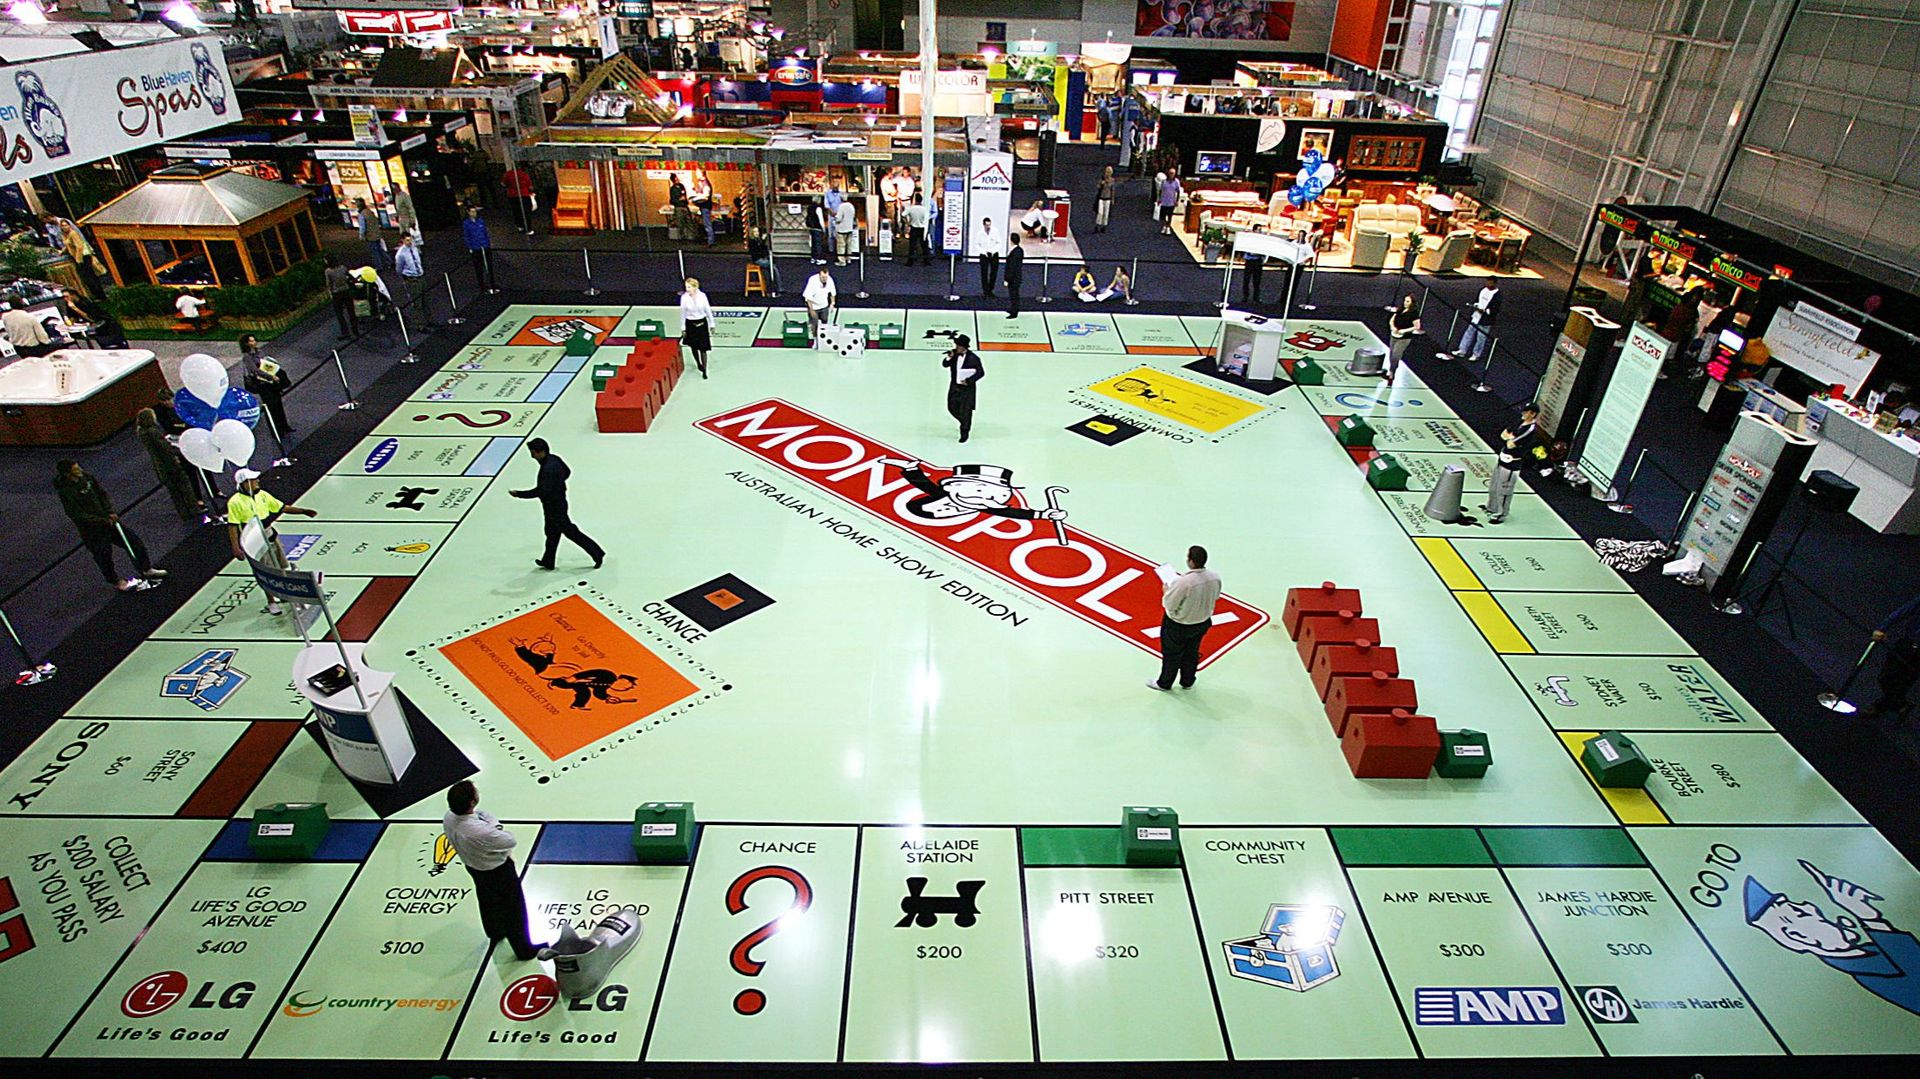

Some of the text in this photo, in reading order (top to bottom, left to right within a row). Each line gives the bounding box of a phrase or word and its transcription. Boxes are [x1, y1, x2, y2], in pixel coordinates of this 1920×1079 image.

[116, 77, 202, 138] Spas
[981, 176, 1006, 185] 100%
[1606, 210, 1624, 225] micro
[1658, 233, 1680, 250] micro
[1720, 261, 1744, 279] micro
[1309, 324, 1364, 341] PARKING
[1068, 398, 1109, 416] CHEST
[1111, 413, 1194, 445] COMMUNITY
[363, 440, 399, 470] SAMSUNG
[316, 540, 338, 556] $200
[725, 470, 1029, 627] AUSTRALIAN HOME SHOW EDITION
[1478, 551, 1505, 576] COLLINS
[1492, 553, 1515, 574] STREET
[192, 580, 259, 635] FREEDOM
[641, 601, 707, 645] CHANCE
[1524, 605, 1560, 640] ELIZABETH
[1540, 611, 1568, 636] STREET
[1583, 675, 1618, 708] SYDNEY
[1601, 678, 1628, 705] WATER
[1638, 681, 1663, 701] $150
[1666, 664, 1742, 723] WATER
[8, 721, 110, 811] SONY
[104, 755, 132, 776] $60
[143, 749, 181, 783] STREET
[161, 750, 196, 781] SONY
[1650, 757, 1692, 797] BOURKE
[1668, 761, 1704, 794] STREET
[1711, 763, 1742, 789] $280
[739, 840, 817, 854] CHANCE
[900, 839, 979, 851] ADELAIDE
[1205, 839, 1306, 853] COMMUNITY
[104, 835, 151, 892] COLLECT
[906, 851, 974, 863] STATION
[1235, 853, 1286, 865] CHEST
[1705, 843, 1742, 872] TO
[61, 834, 125, 924] $200 SALARY
[246, 886, 272, 898] LG
[385, 887, 472, 900] COUNTRY
[586, 889, 609, 901] LG
[1060, 891, 1155, 904] PITT STREET
[1382, 891, 1493, 904] AMP AVENUE
[1536, 890, 1657, 903] JAMES HARDIE
[1690, 869, 1729, 908] GO
[28, 852, 88, 944] AS YOU PASS
[190, 899, 308, 913] LIFE'S GOOD
[382, 902, 458, 915] ENERGY
[1563, 904, 1649, 917] JUNCTION
[201, 915, 278, 928] AVENUE
[196, 939, 248, 954] $400
[379, 941, 425, 955] $100
[916, 944, 962, 959] $200
[1095, 944, 1139, 959] $320
[1439, 943, 1486, 958] $300
[1606, 942, 1653, 957] $300
[187, 981, 257, 1010] LG
[1632, 996, 1745, 1010] James Hardie
[1458, 989, 1560, 1022] AMP
[96, 1026, 230, 1042] Life's Good
[487, 1030, 618, 1044] Life's Good
